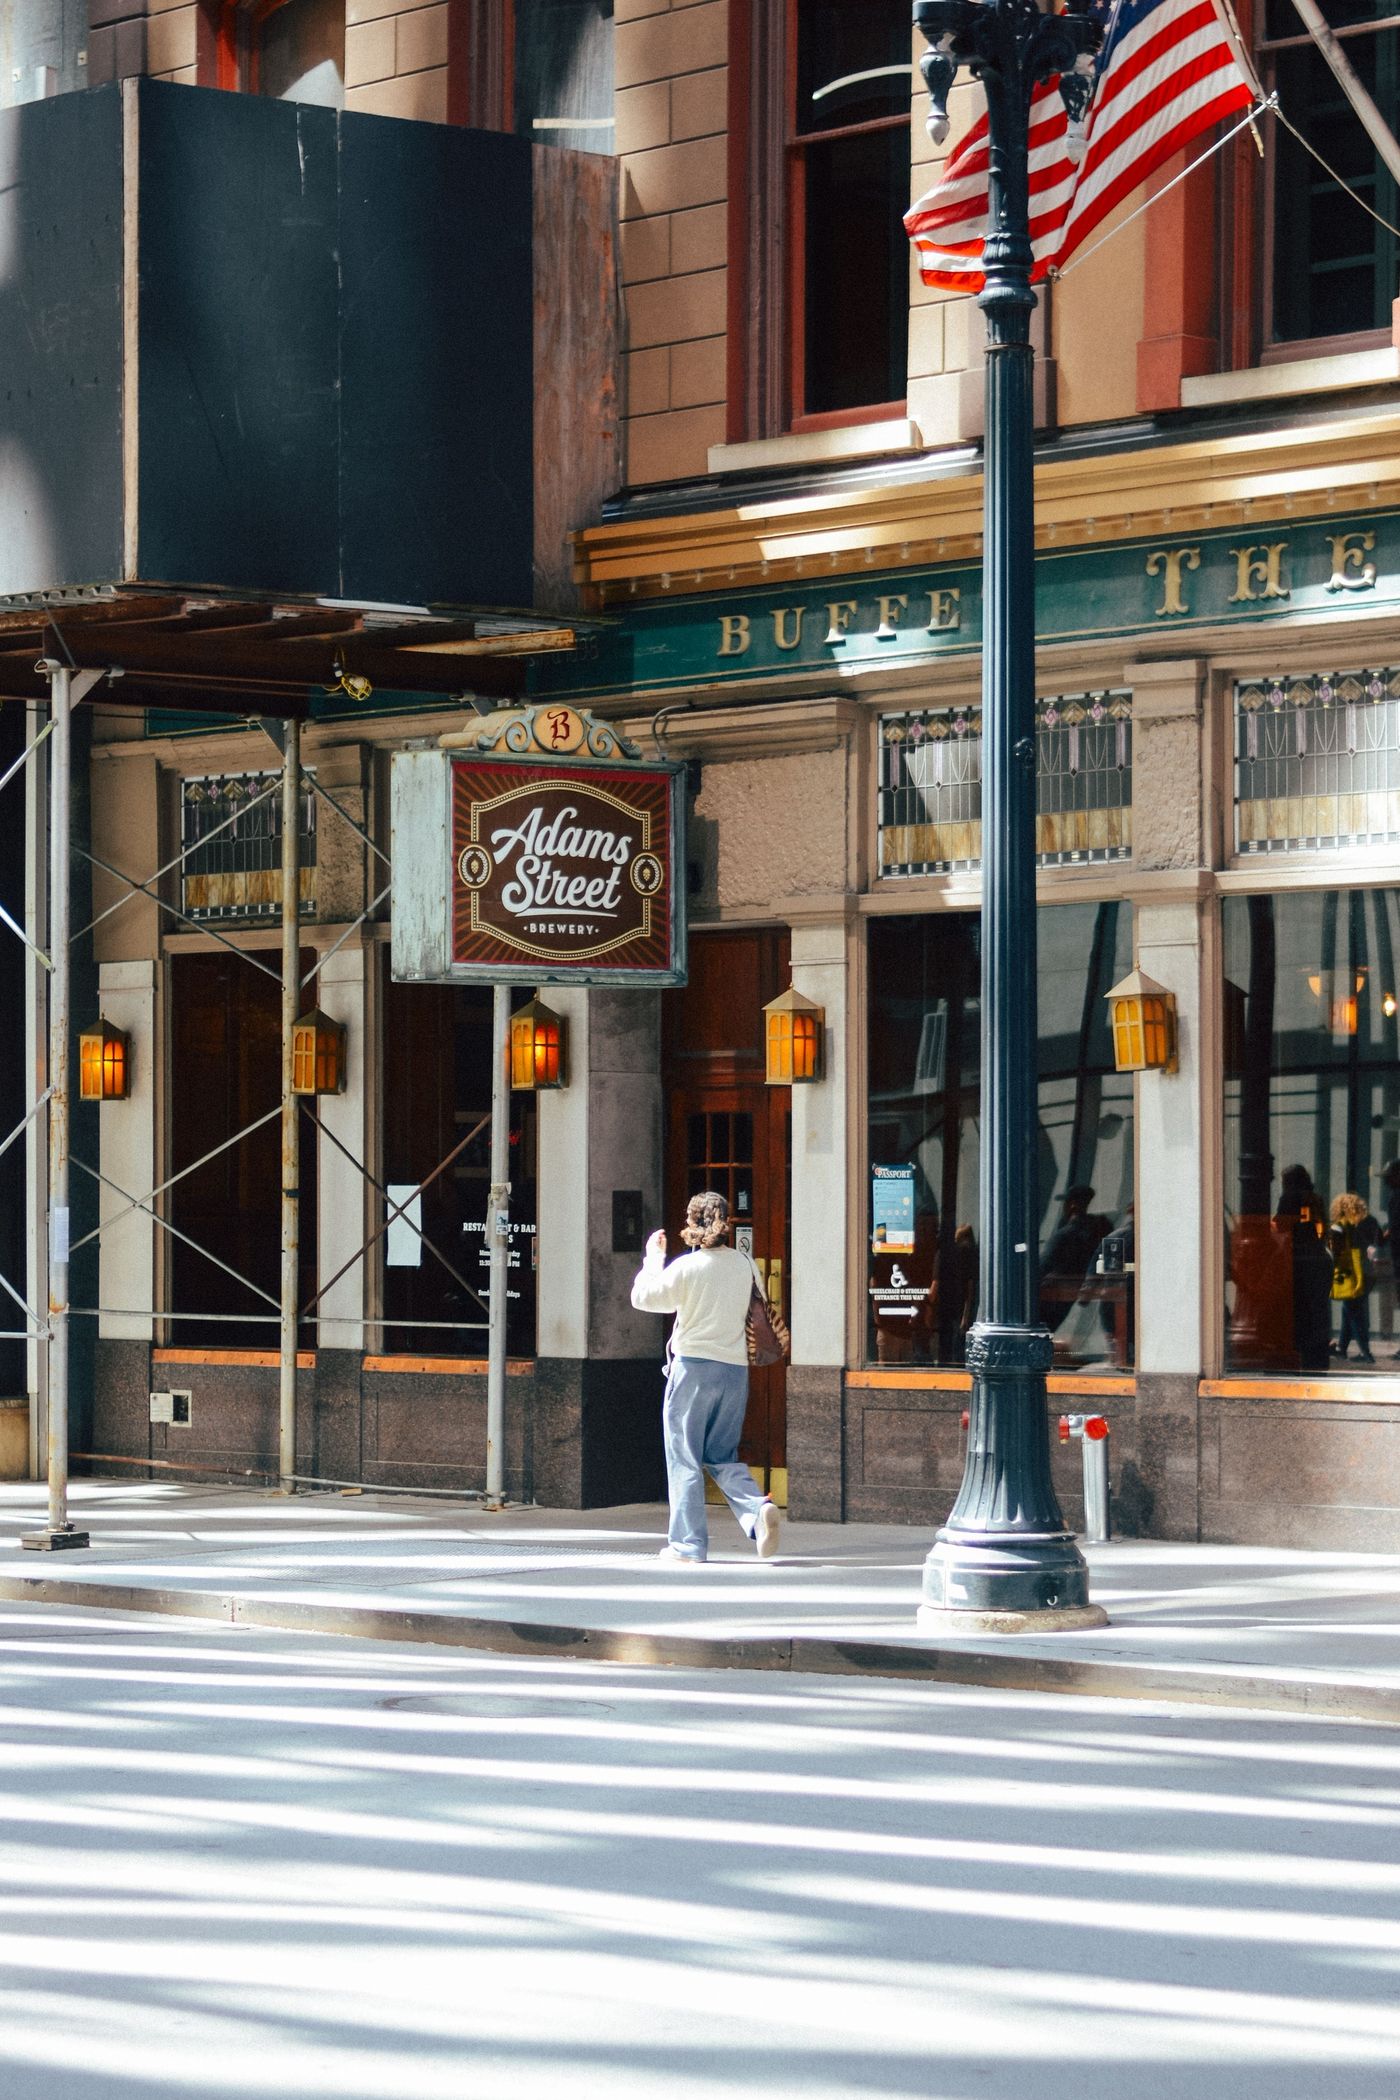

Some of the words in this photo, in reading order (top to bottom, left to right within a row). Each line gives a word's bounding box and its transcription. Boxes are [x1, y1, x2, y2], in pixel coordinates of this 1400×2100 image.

[1146, 530, 1376, 616] THE
[547, 711, 570, 749] B
[490, 807, 633, 866] Adams
[501, 854, 623, 914] Street
[529, 922, 595, 935] BREWERY
[513, 1224, 520, 1233] &
[521, 1224, 536, 1233] BAR
